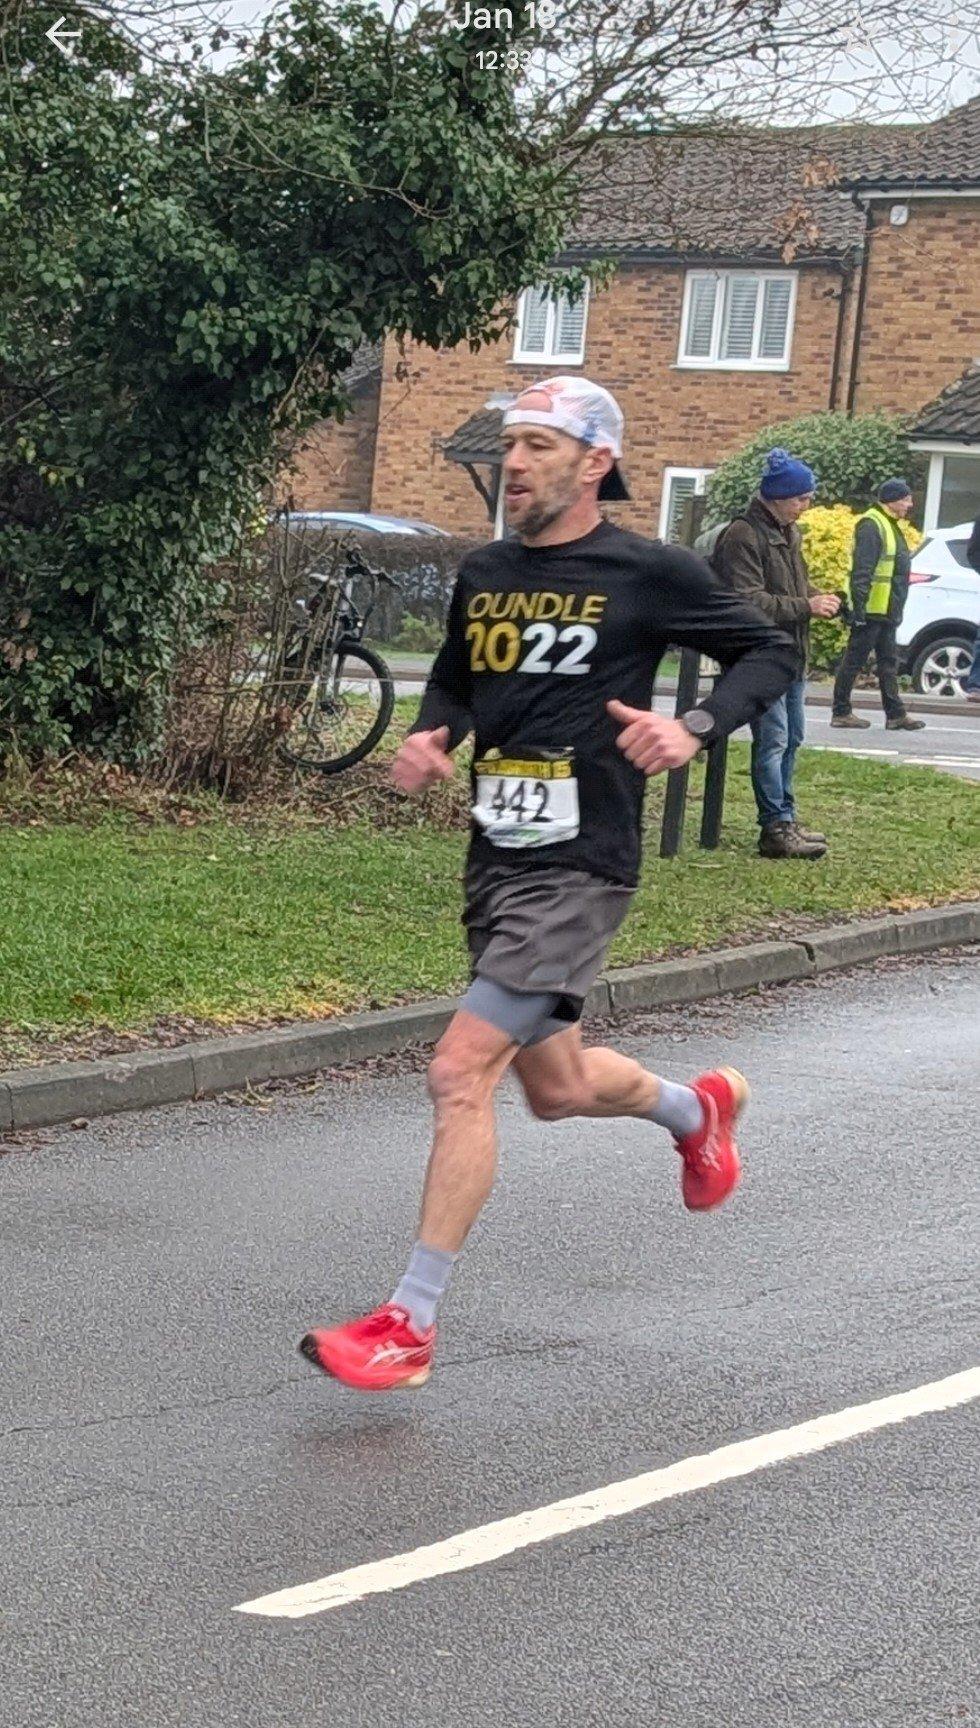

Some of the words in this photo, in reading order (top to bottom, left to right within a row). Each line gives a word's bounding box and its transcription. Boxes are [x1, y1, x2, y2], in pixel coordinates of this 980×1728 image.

[467, 592, 608, 623] OUNDLE
[465, 621, 598, 675] 2022
[489, 779, 553, 822] 442
